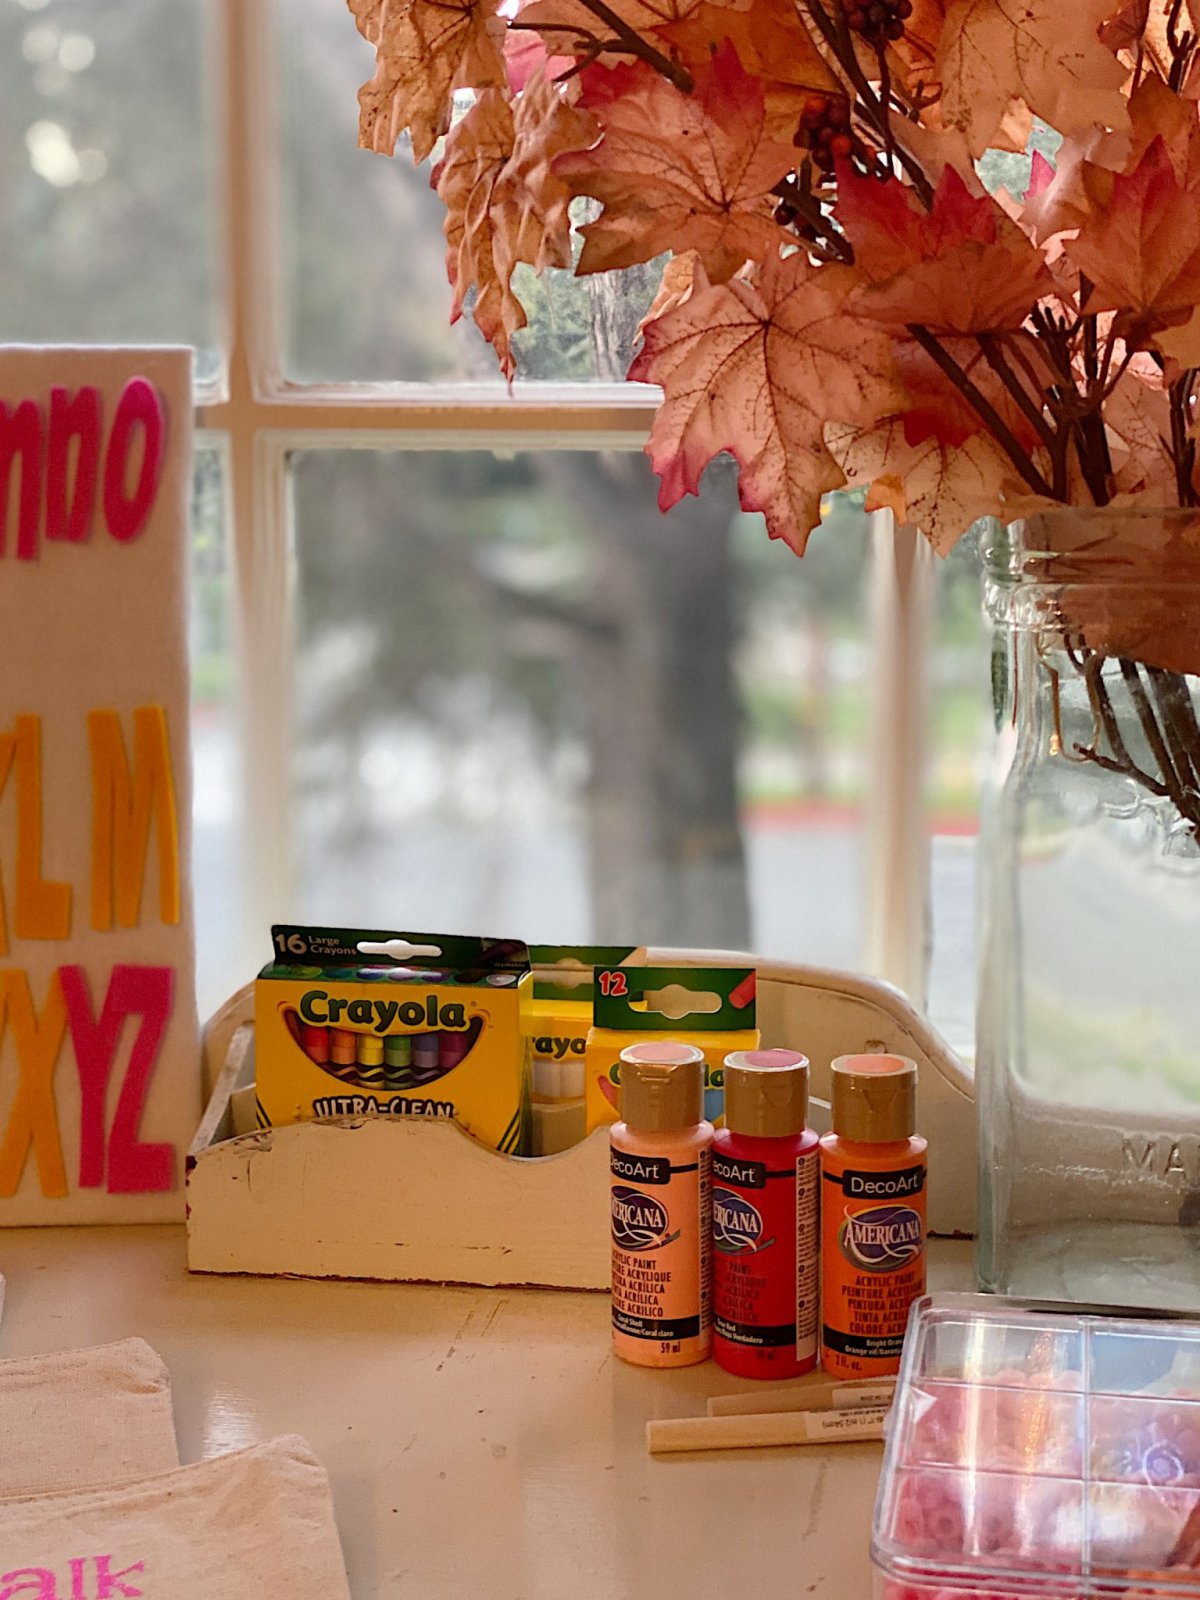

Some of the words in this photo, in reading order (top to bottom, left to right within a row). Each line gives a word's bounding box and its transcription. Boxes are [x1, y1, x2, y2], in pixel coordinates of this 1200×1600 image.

[274, 932, 308, 955] 16
[308, 935, 340, 947] Large
[310, 944, 357, 957] Crayons
[598, 970, 629, 997] 12
[299, 990, 467, 1033] Crayola
[0, 965, 174, 1198] XYZ
[313, 1095, 454, 1119] ULTRA-CLEAN
[712, 1160, 756, 1183] ecoArt
[850, 1174, 919, 1194] DecoArt
[843, 1218, 920, 1249] AMERICANA
[633, 1258, 657, 1271] PAINT
[627, 1268, 672, 1283] ACRYLIQUE
[855, 1275, 893, 1287] ACRYLIC
[841, 1284, 884, 1299] PEINTURE
[847, 1298, 886, 1311] PINTURA
[854, 1311, 880, 1323] TINTA
[850, 1322, 884, 1335] COLORE
